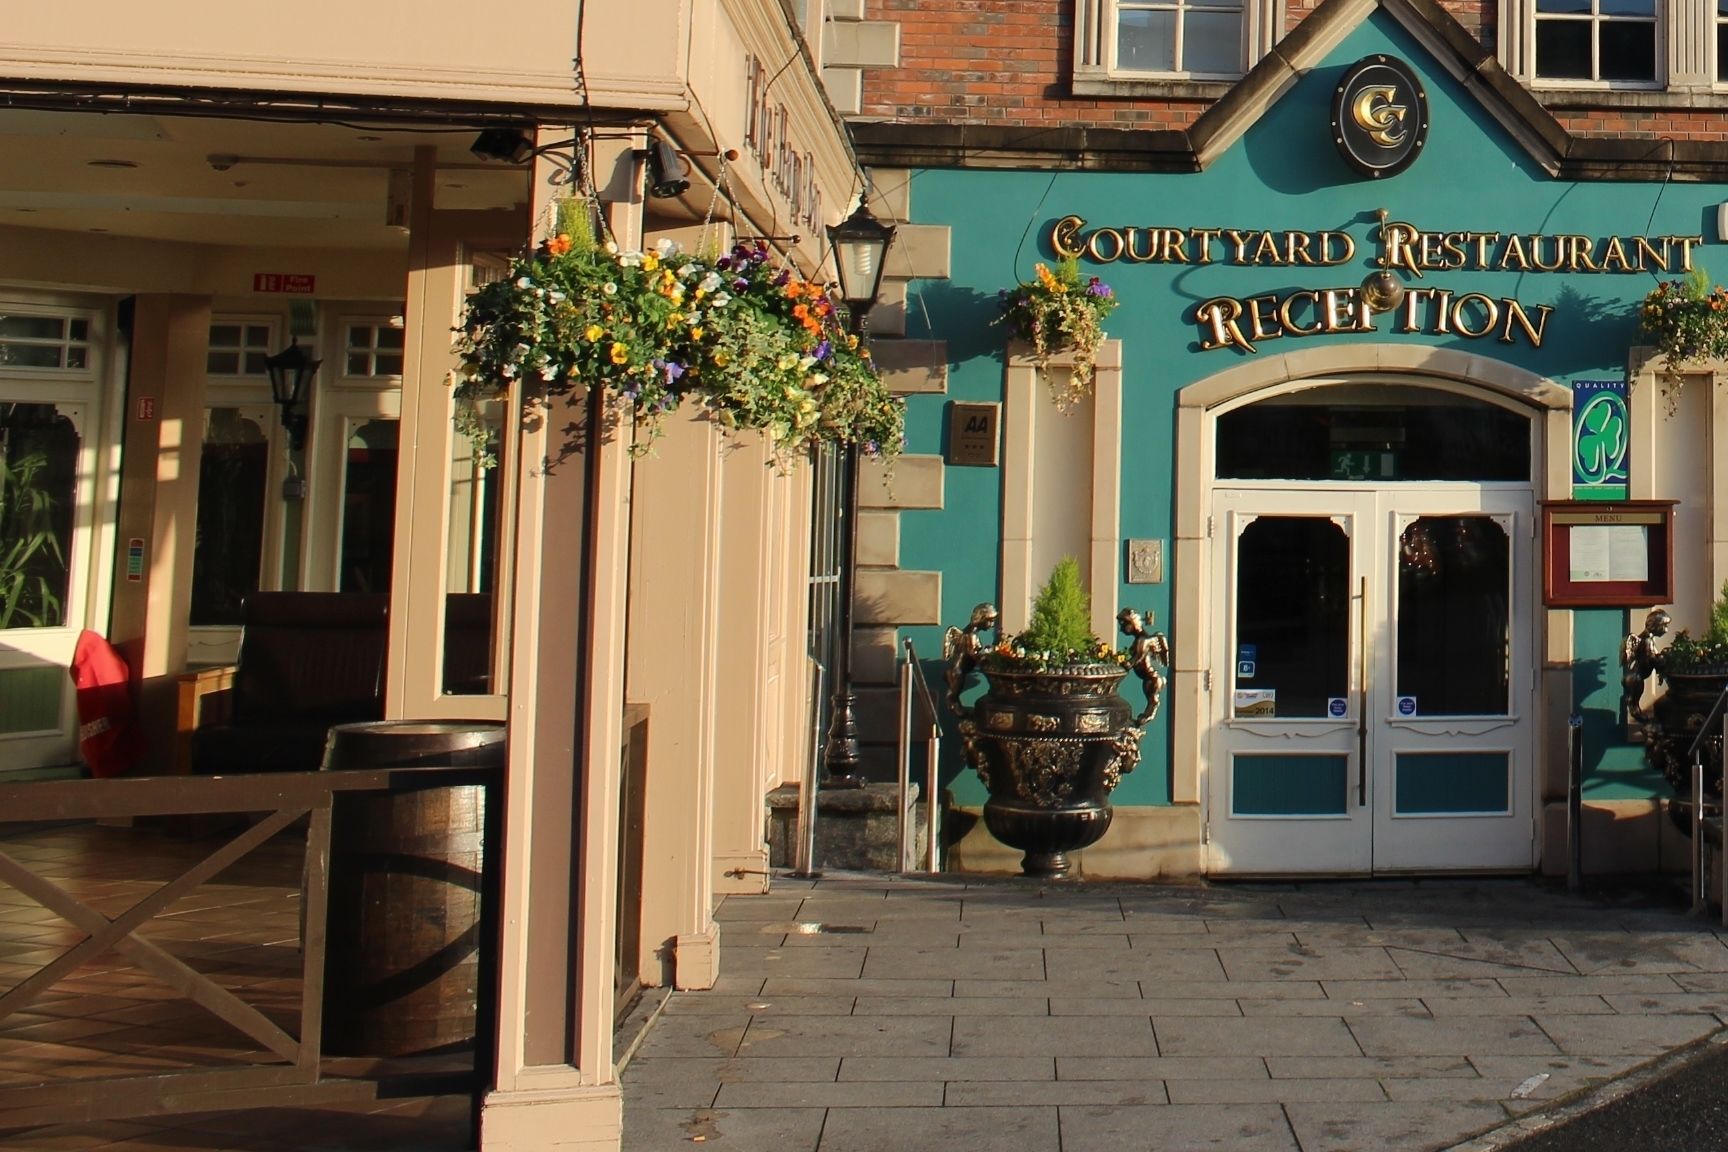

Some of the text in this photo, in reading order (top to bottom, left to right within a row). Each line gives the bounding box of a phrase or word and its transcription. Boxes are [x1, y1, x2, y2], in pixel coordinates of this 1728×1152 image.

[1051, 214, 1703, 279] COURTYARD RESTAURANT
[1575, 381, 1625, 389] QUALITY
[963, 415, 988, 434] AA
[1594, 514, 1622, 523] MENU
[1256, 707, 1274, 715] 2014
